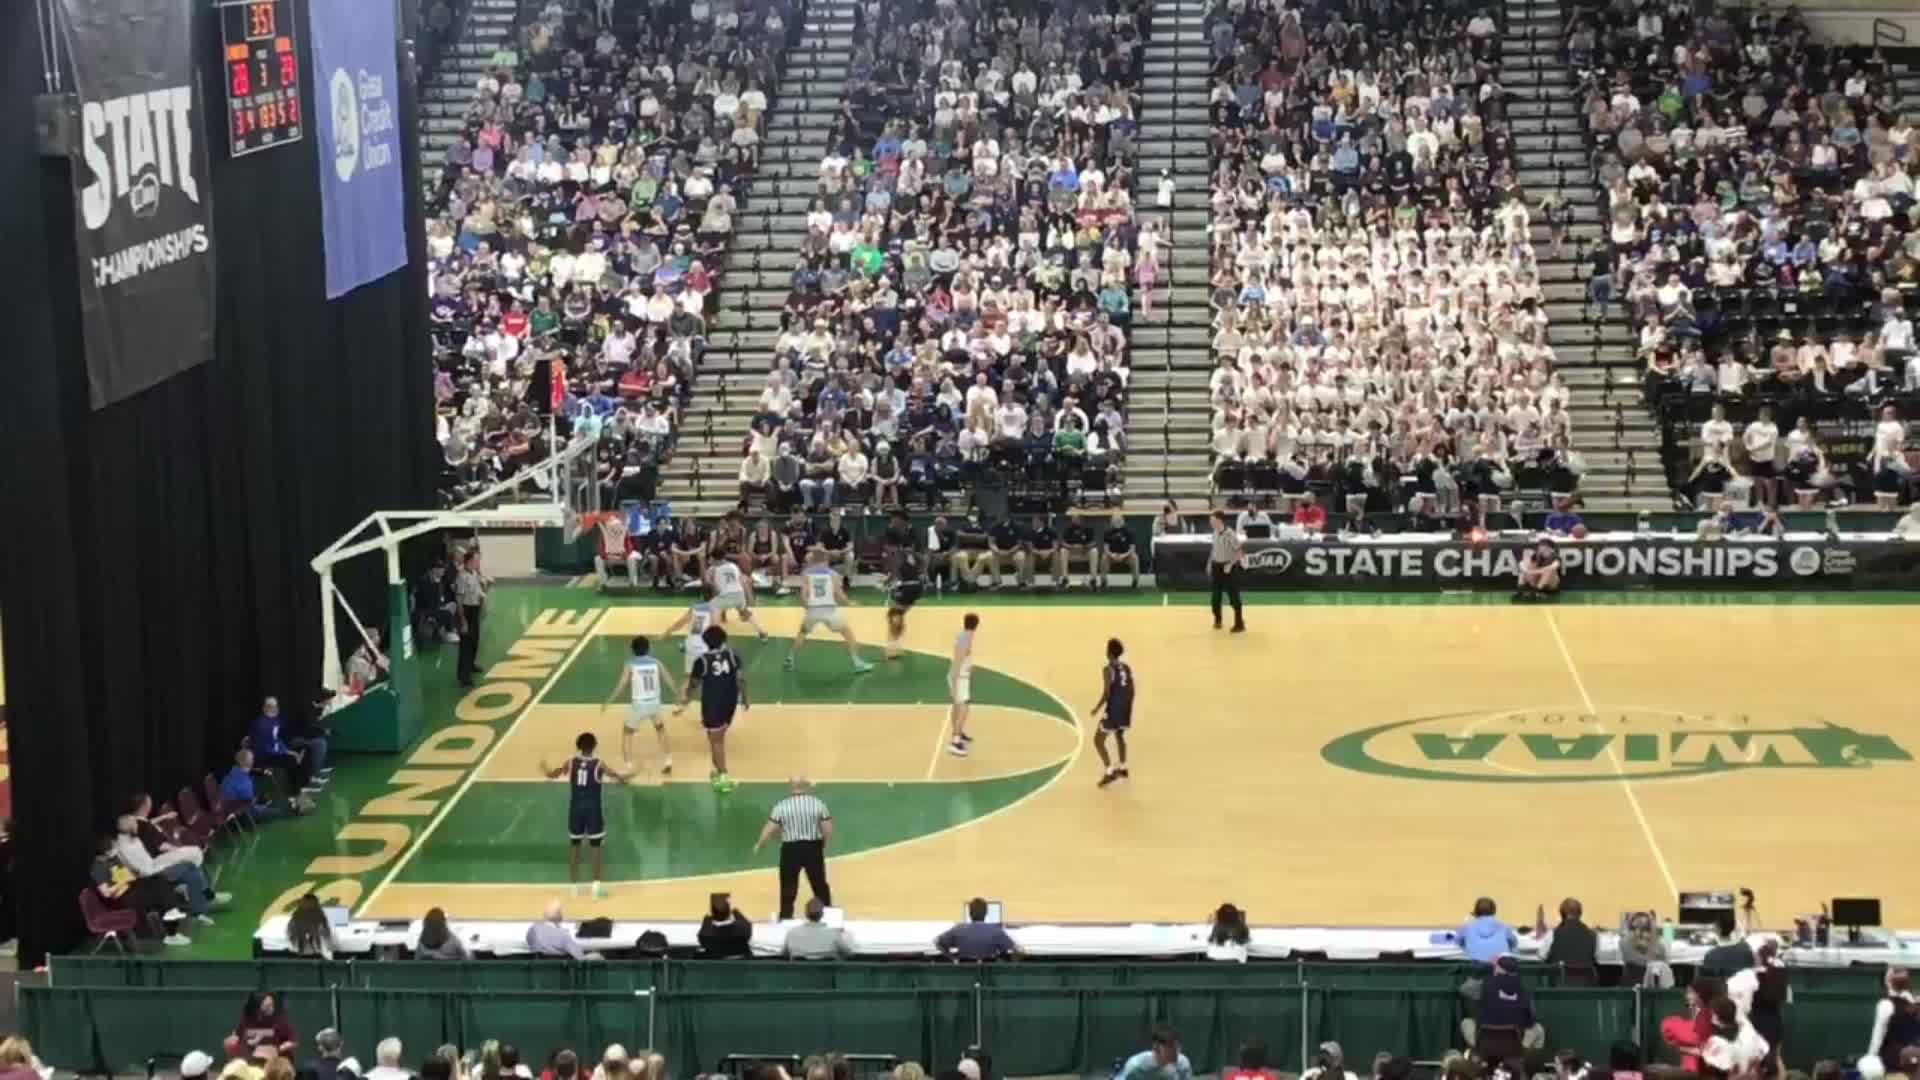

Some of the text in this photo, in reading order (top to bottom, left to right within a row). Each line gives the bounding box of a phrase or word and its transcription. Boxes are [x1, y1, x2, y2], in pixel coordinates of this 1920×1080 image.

[82, 86, 199, 229] STATE
[1304, 548, 1423, 577] STATE
[1433, 547, 1779, 577] CHAPIONSHIPS
[711, 659, 730, 676] 34
[642, 675, 655, 692] 11
[1412, 733, 1822, 765] WIAA
[577, 769, 588, 786] 11
